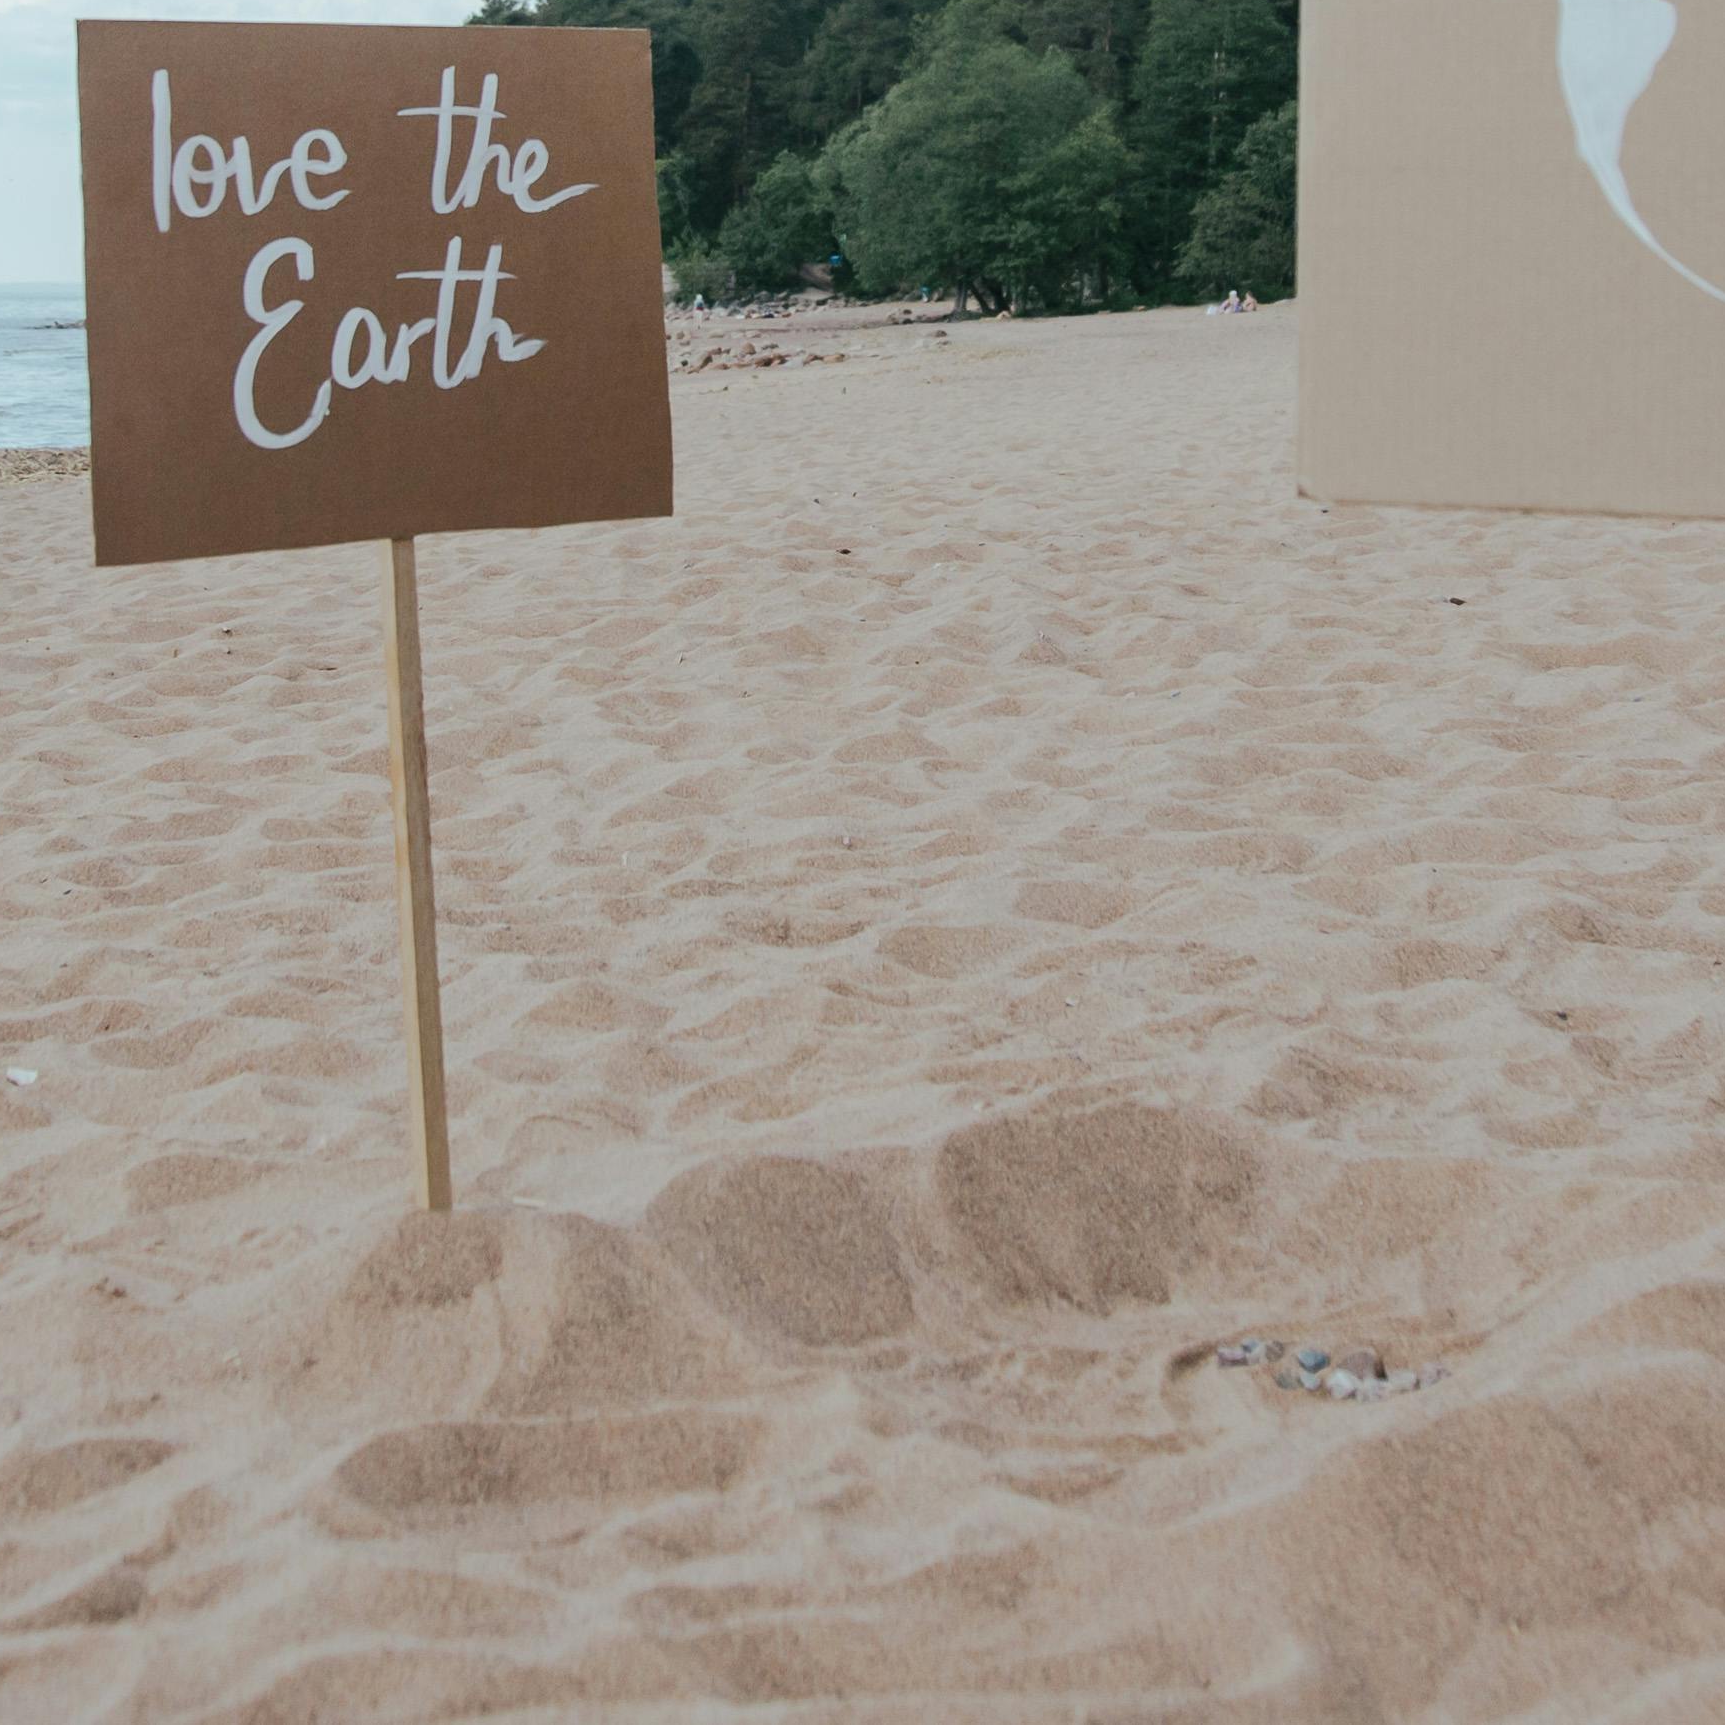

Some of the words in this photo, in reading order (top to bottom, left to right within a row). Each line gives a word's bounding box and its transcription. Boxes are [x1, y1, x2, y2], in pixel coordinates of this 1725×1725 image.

[152, 68, 351, 233] love
[397, 66, 599, 214] the
[233, 236, 548, 449] Earth
